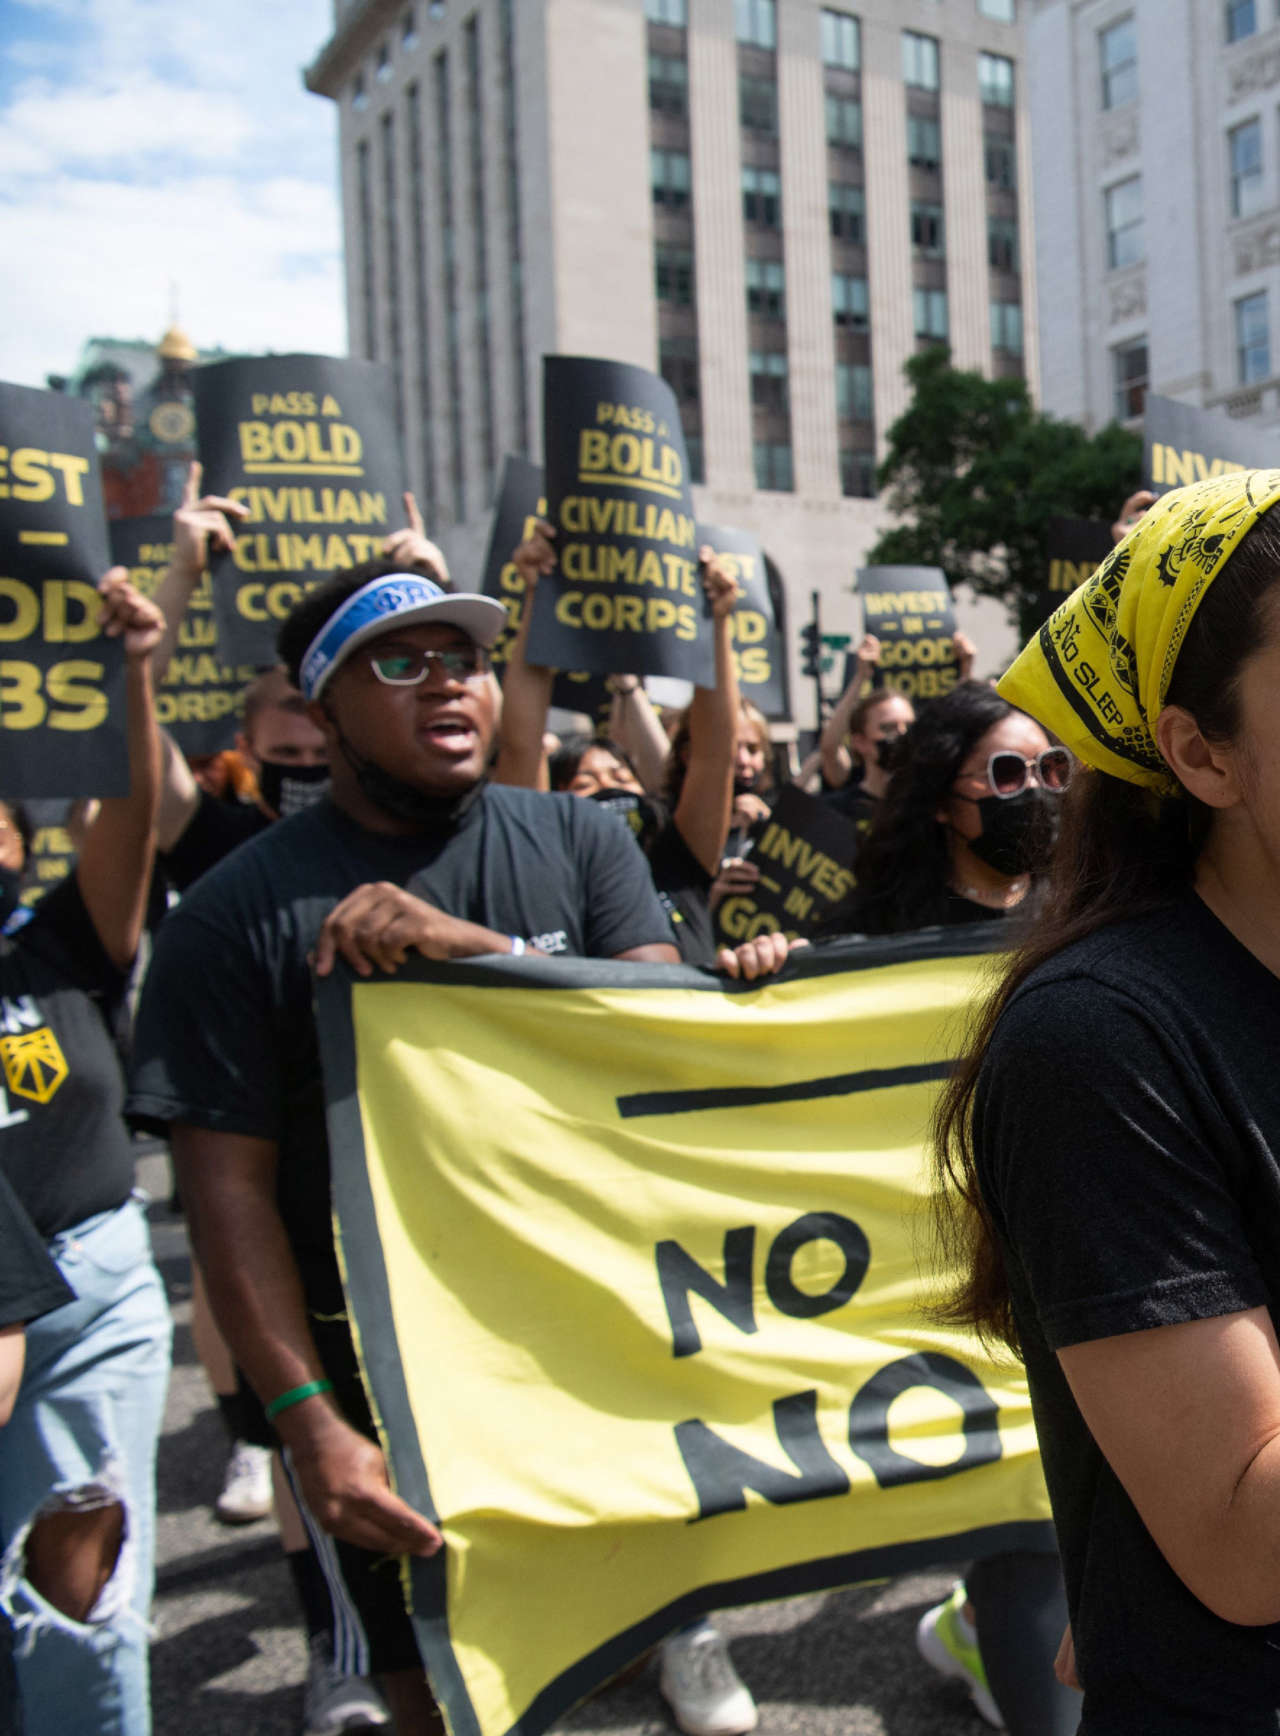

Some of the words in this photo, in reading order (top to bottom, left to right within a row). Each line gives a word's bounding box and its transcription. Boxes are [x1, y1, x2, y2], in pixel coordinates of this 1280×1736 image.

[252, 391, 319, 417] PASS
[321, 393, 342, 418] A
[597, 402, 655, 434] PASS
[239, 421, 363, 464] BOLD
[579, 428, 683, 488] BOLD
[1152, 442, 1246, 487] INV
[226, 486, 388, 525] CIVILIAN
[560, 496, 697, 549] CIVILIAN
[561, 543, 697, 598] CLIMATE
[554, 591, 697, 641] CORPS
[864, 590, 948, 615] INVEST
[1073, 661, 1124, 726] SLEEP
[758, 822, 858, 902] INVES
[655, 1211, 871, 1358] NO
[674, 1351, 1003, 1525] NO
